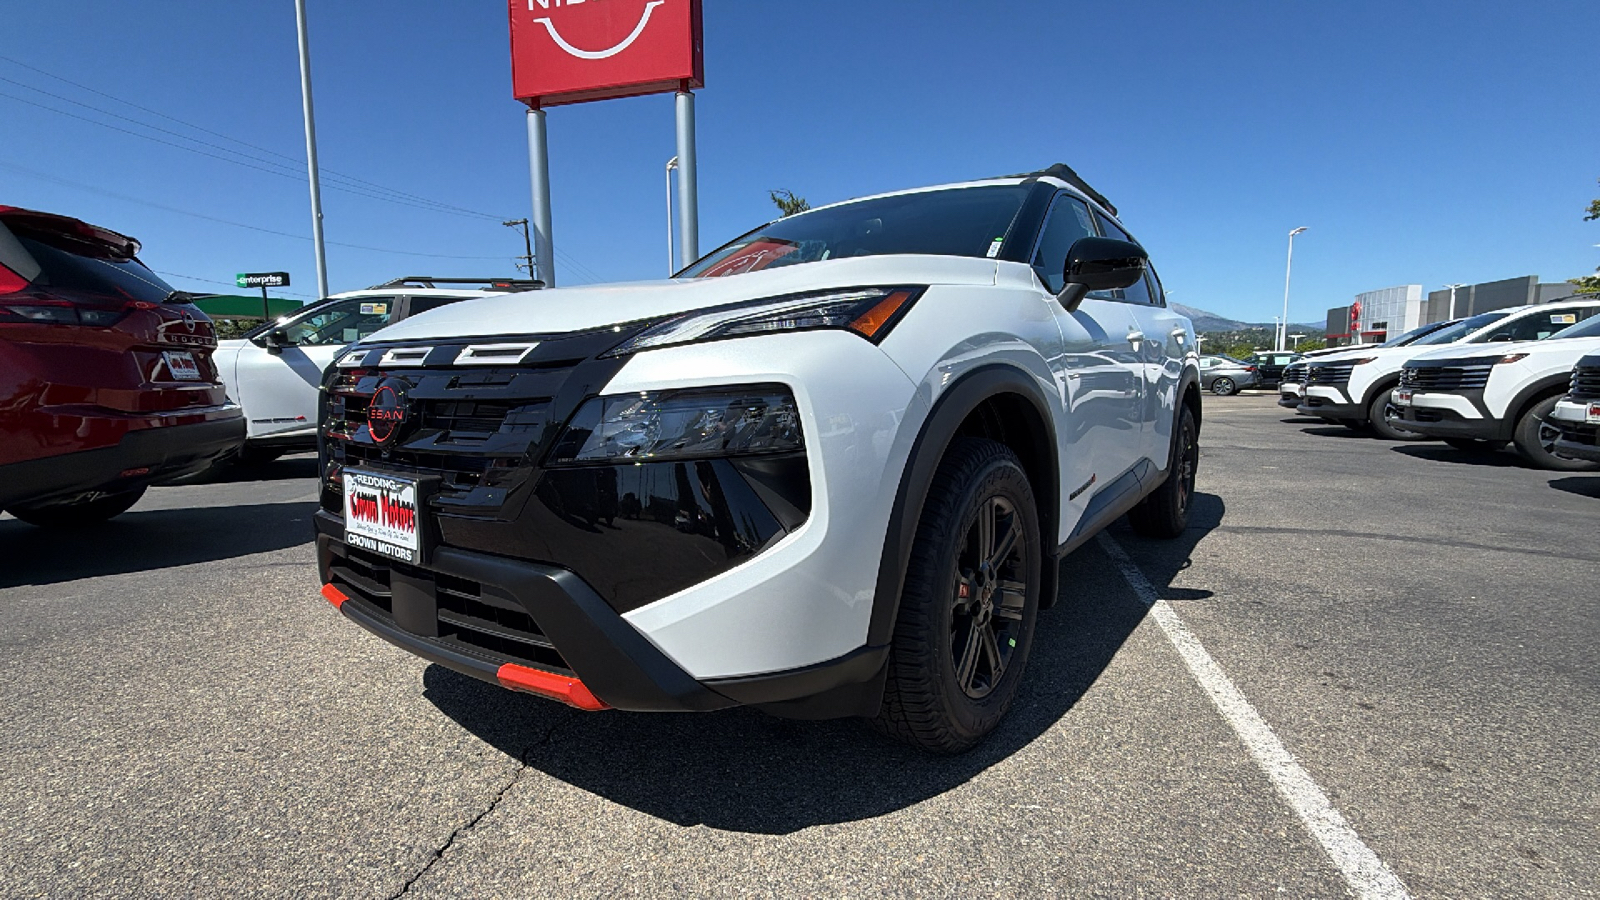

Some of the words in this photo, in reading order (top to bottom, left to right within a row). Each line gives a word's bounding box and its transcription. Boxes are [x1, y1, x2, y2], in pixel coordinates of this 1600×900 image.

[238, 274, 282, 285] enterprise
[356, 474, 396, 490] REDDING
[350, 492, 378, 524] Crown
[380, 491, 415, 533] Motors
[348, 534, 377, 551] CROWN
[378, 542, 412, 561] MOTORS
